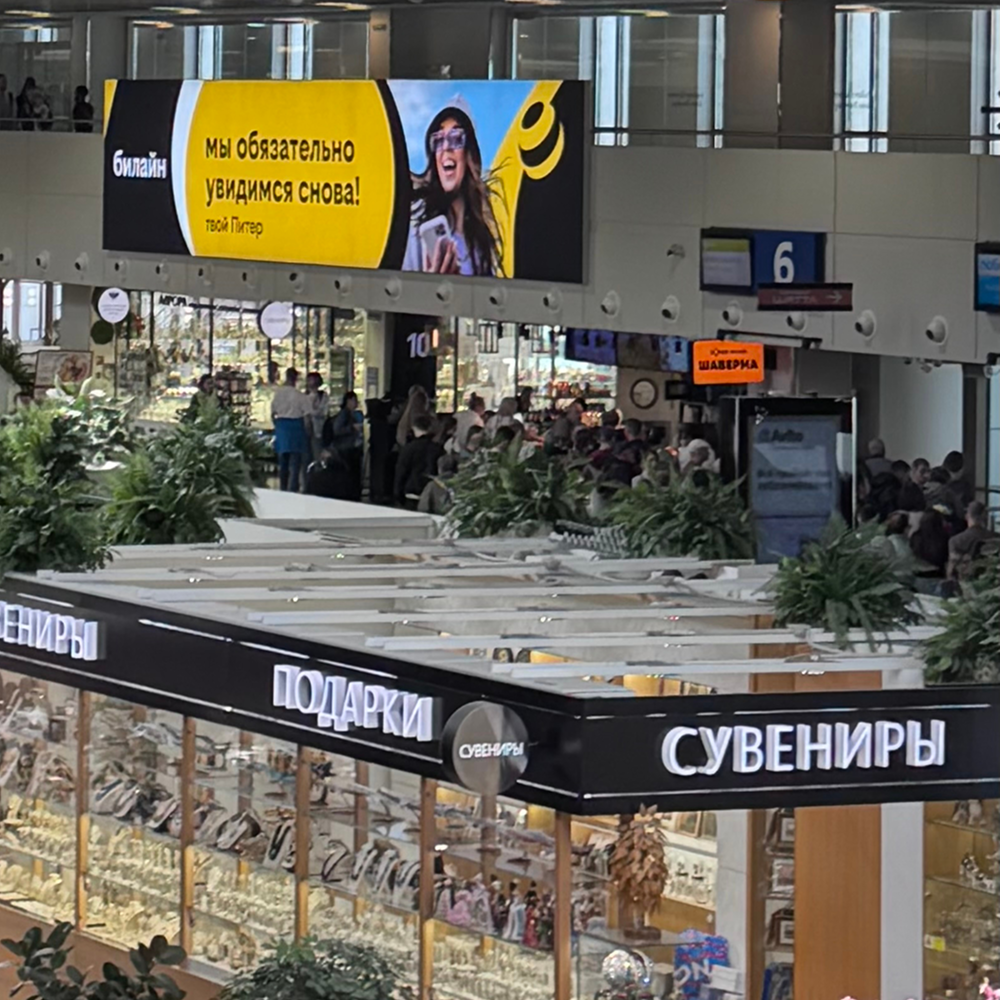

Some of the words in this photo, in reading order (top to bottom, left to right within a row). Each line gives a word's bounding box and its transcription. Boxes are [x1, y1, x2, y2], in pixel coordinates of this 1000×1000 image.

[205, 136, 231, 159] мы
[236, 130, 355, 163] обязательно
[112, 149, 167, 179] билайн
[205, 177, 293, 207] увидимся
[298, 176, 360, 206] снова!
[205, 216, 228, 233] твой
[230, 216, 264, 239] Питер
[773, 241, 795, 284] 6
[406, 332, 430, 358] 10
[698, 358, 759, 371] ШАВЕРМА
[272, 664, 434, 742] ПОДАРКИ
[458, 742, 524, 759] СУВЕНИРЫ
[661, 719, 946, 777] СУВЕНИРЫ
